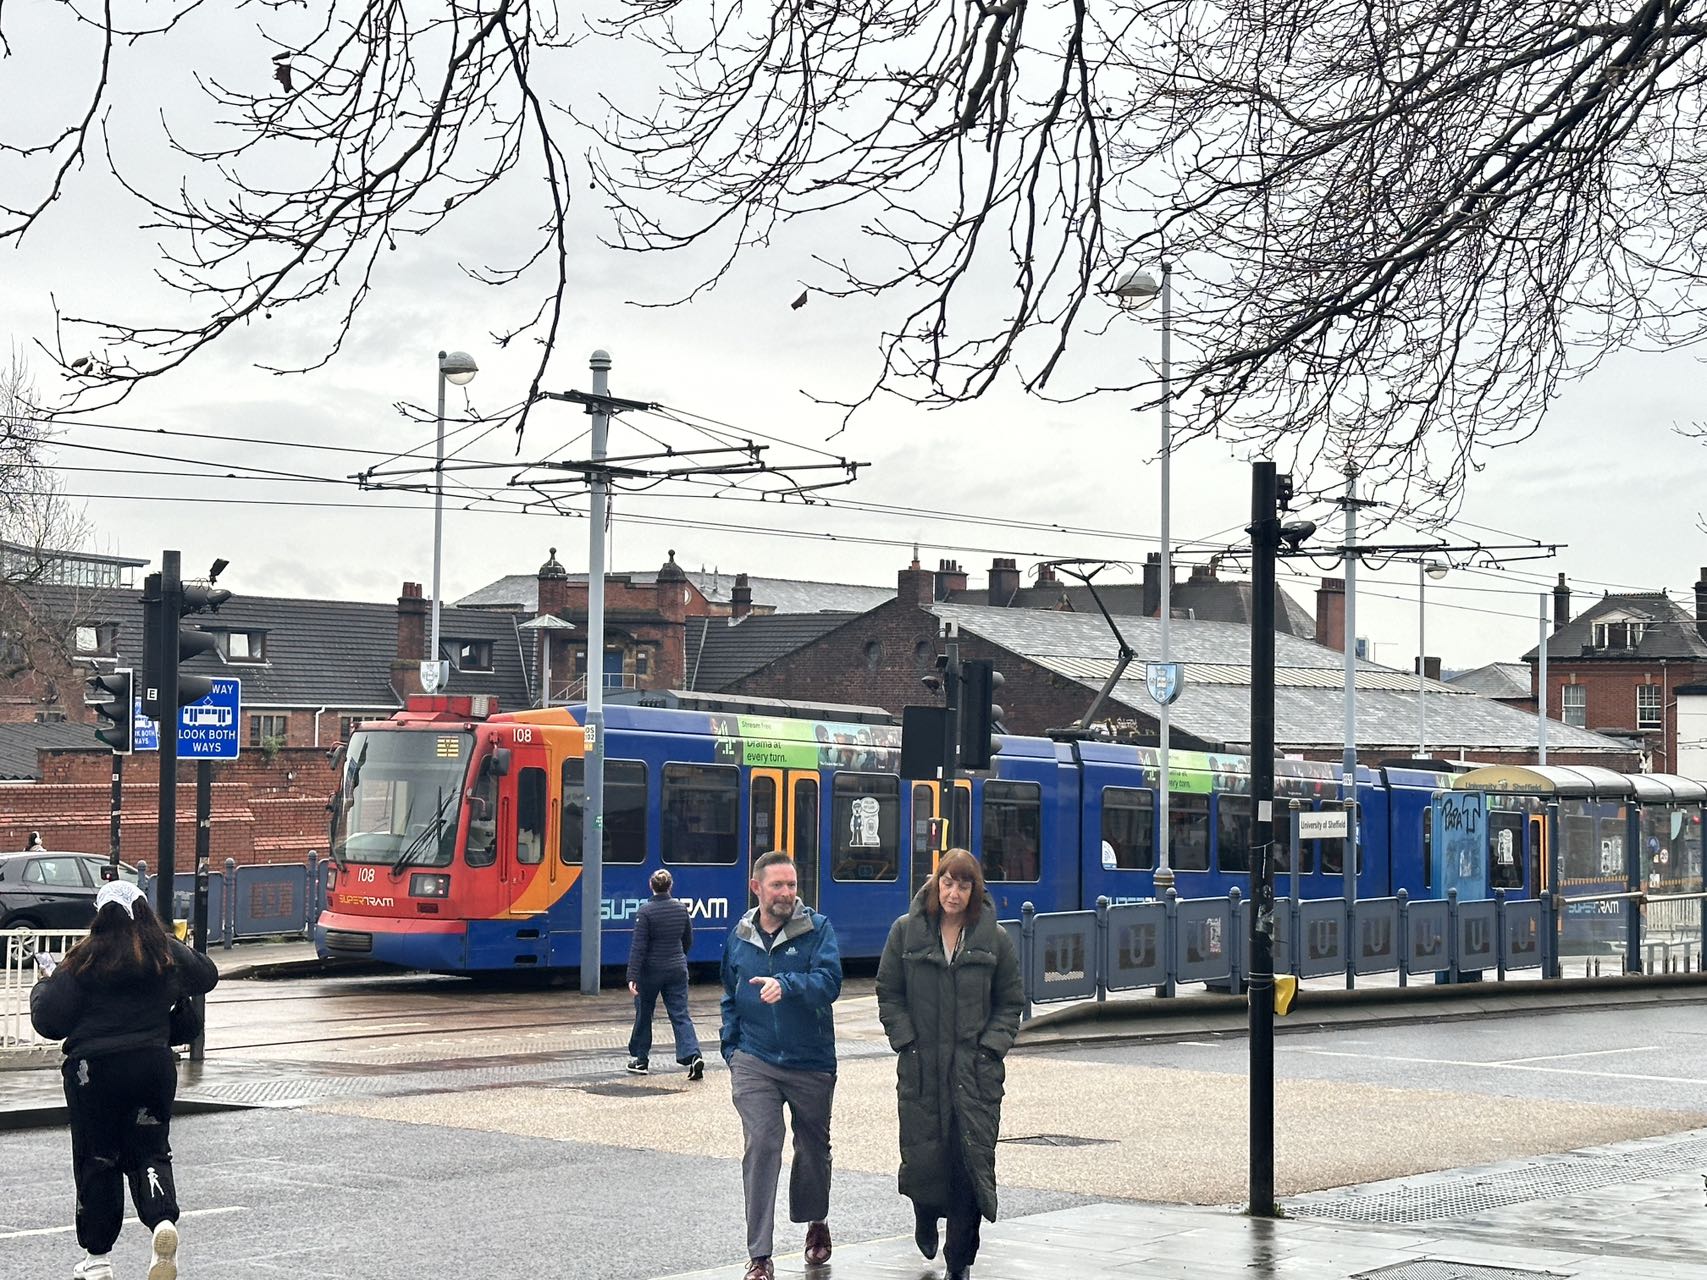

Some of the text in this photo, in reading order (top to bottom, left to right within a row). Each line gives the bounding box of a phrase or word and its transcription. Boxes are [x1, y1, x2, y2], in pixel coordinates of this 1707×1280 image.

[149, 690, 156, 698] E
[178, 730, 236, 740] LOOK BOTH
[512, 728, 532, 742] 108
[192, 743, 221, 752] WAYS
[746, 752, 787, 764] every turn.
[1465, 782, 1498, 791] University
[1512, 783, 1543, 792] Sheffield
[1301, 820, 1346, 831] University of Sheffield
[357, 867, 376, 883] 108
[338, 894, 394, 907] SUPERTRAM
